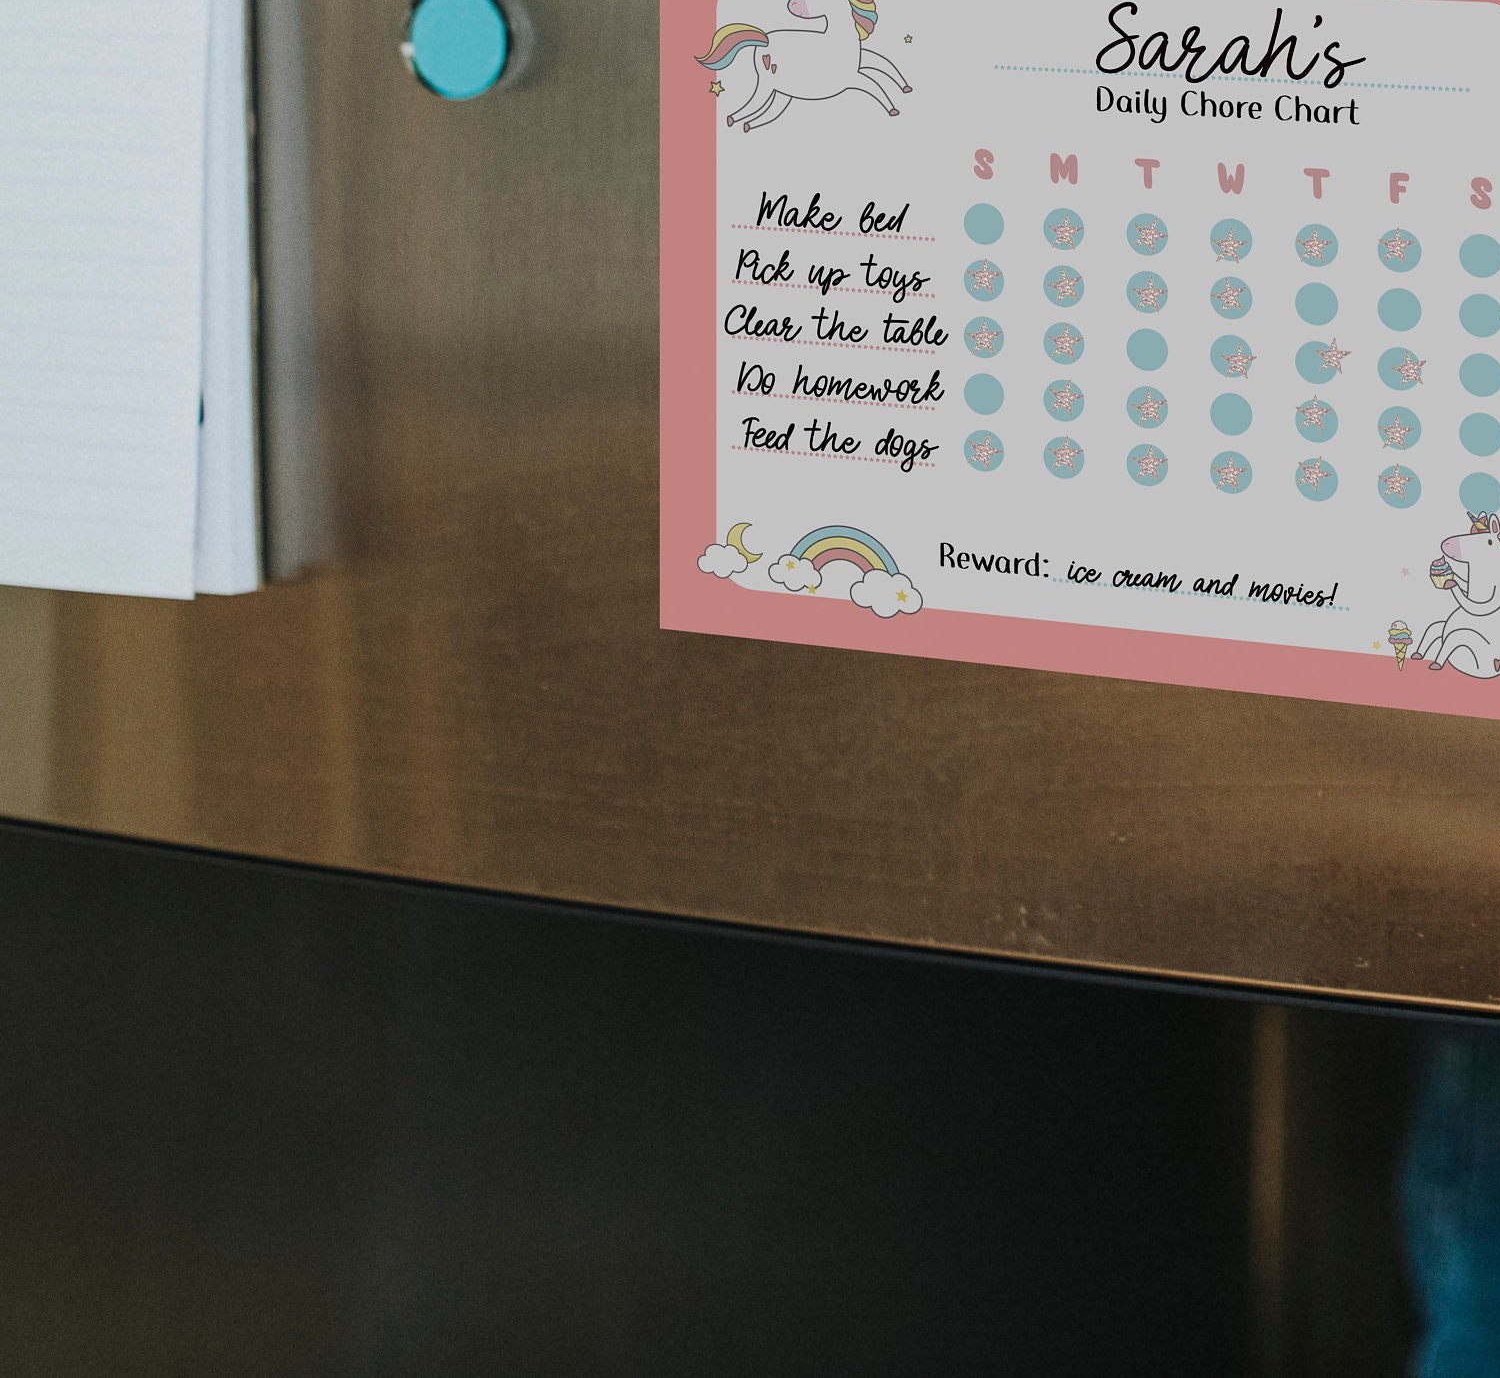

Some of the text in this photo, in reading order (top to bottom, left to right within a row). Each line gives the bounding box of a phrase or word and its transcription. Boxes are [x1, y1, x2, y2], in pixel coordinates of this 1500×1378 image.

[1096, 2, 1366, 88] Sarah's
[1097, 86, 1359, 124] Daily Chore Chart
[974, 149, 1492, 210] S M T W T F S
[757, 192, 909, 233] Make bed
[736, 249, 930, 303] Pick up toys
[725, 305, 949, 346] Clear the table
[737, 361, 945, 404] Do homework
[742, 417, 939, 472] Feed the dogs
[940, 543, 1338, 607] Reward: ice cream and movies!
